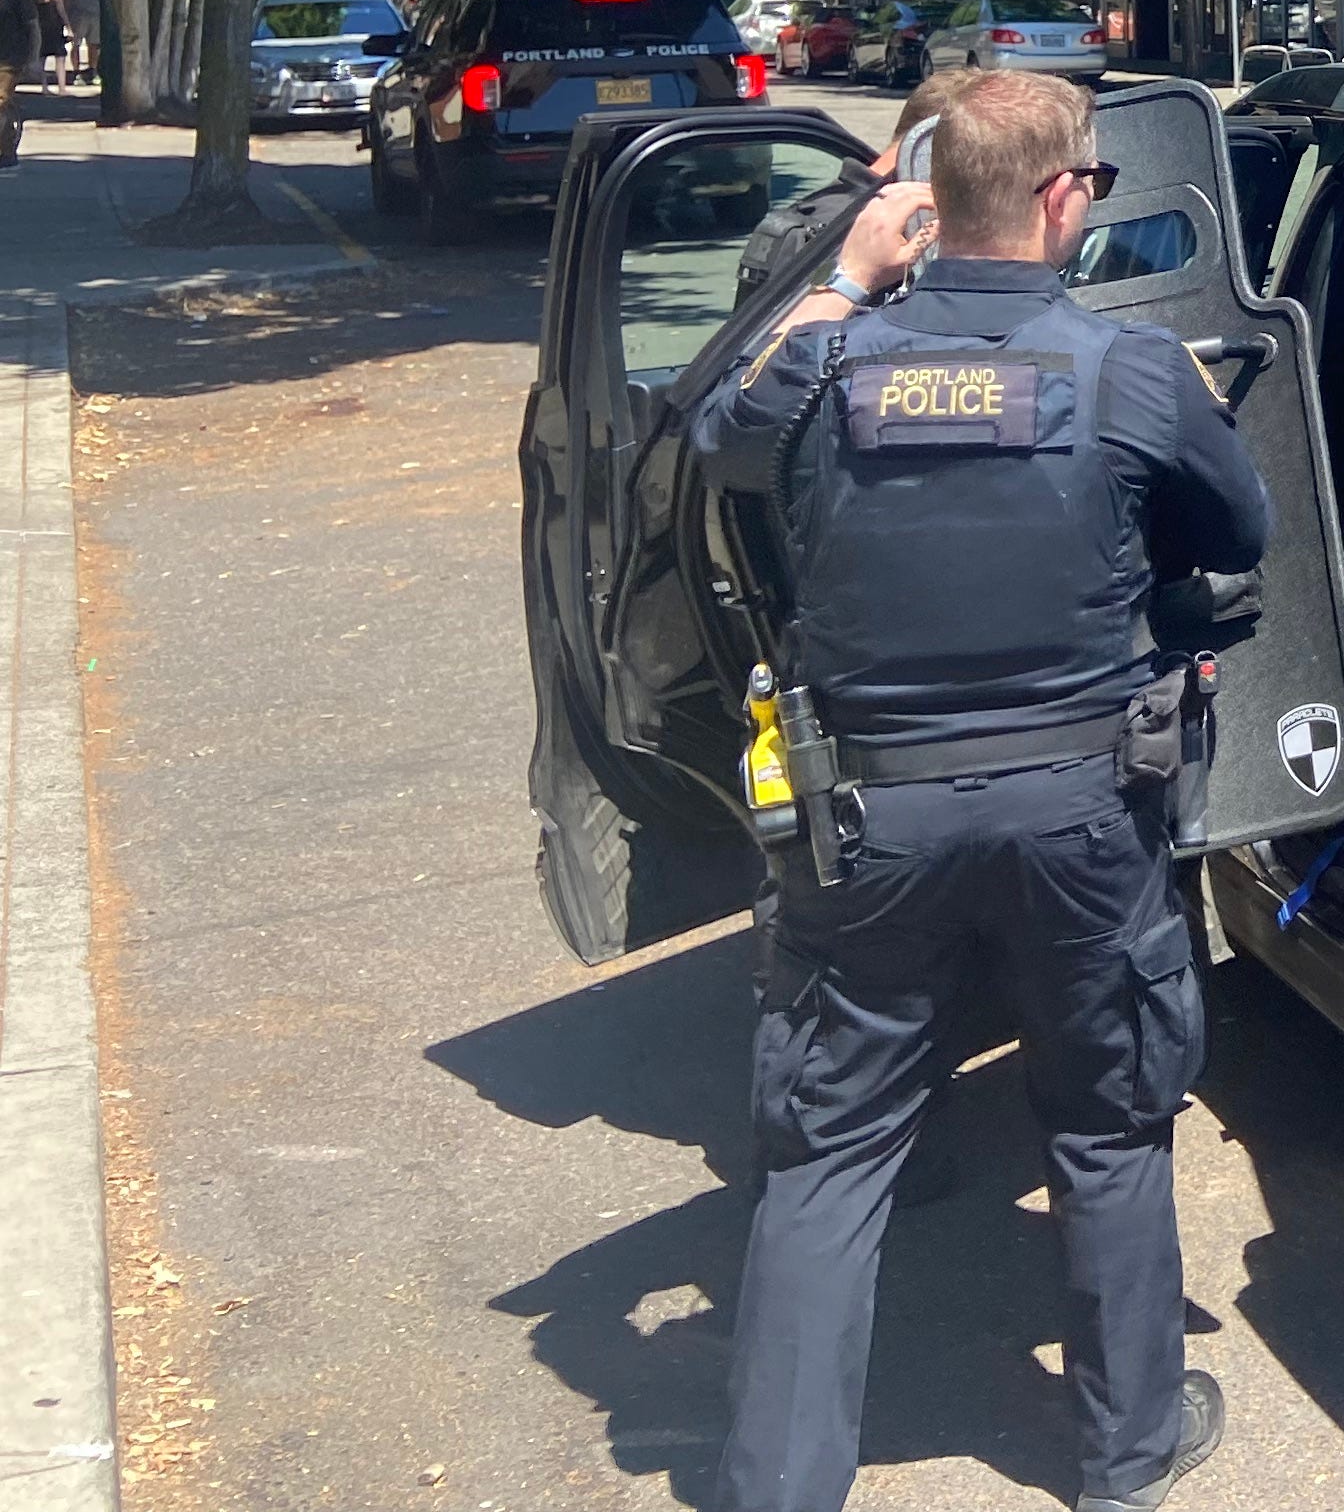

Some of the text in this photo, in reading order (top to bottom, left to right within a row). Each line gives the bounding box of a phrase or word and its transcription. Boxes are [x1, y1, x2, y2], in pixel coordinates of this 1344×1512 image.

[502, 44, 710, 62] PORTLAND POLICE
[891, 368, 996, 386] PORTLAND
[879, 385, 1005, 417] POLICE
